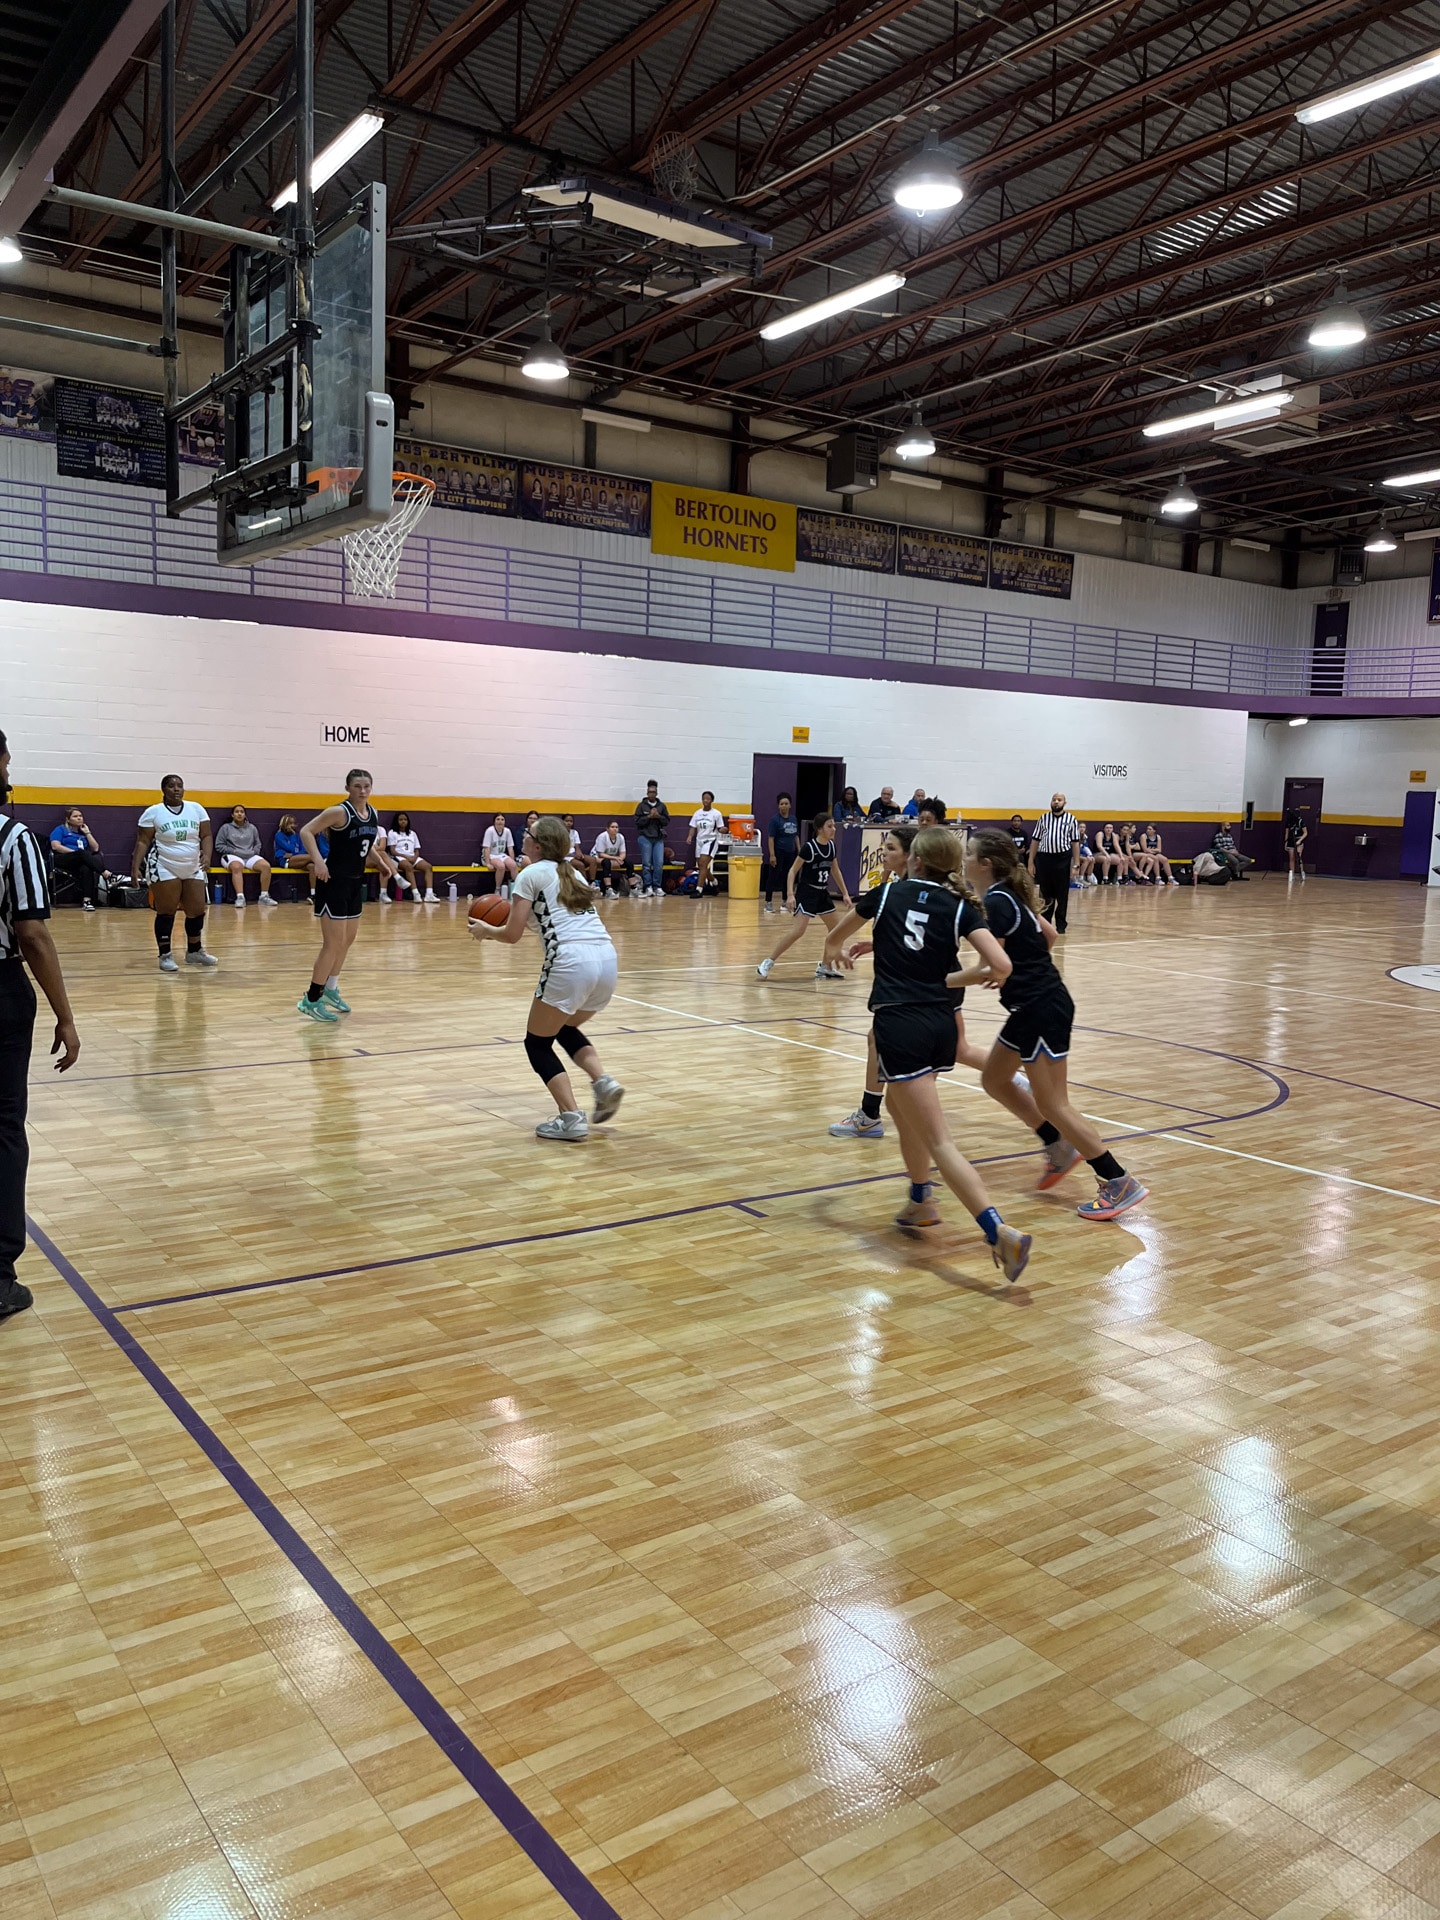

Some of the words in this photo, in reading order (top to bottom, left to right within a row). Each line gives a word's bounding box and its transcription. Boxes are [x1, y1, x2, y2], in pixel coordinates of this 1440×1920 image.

[466, 497, 507, 510] CHAMPIONS
[675, 497, 776, 536] BERTOLINO
[683, 526, 768, 555] HORNETS
[325, 725, 370, 743] HOME
[1093, 764, 1128, 777] VISITORS
[360, 839, 370, 857] 3
[818, 870, 829, 882] 13
[904, 910, 929, 951] 5
